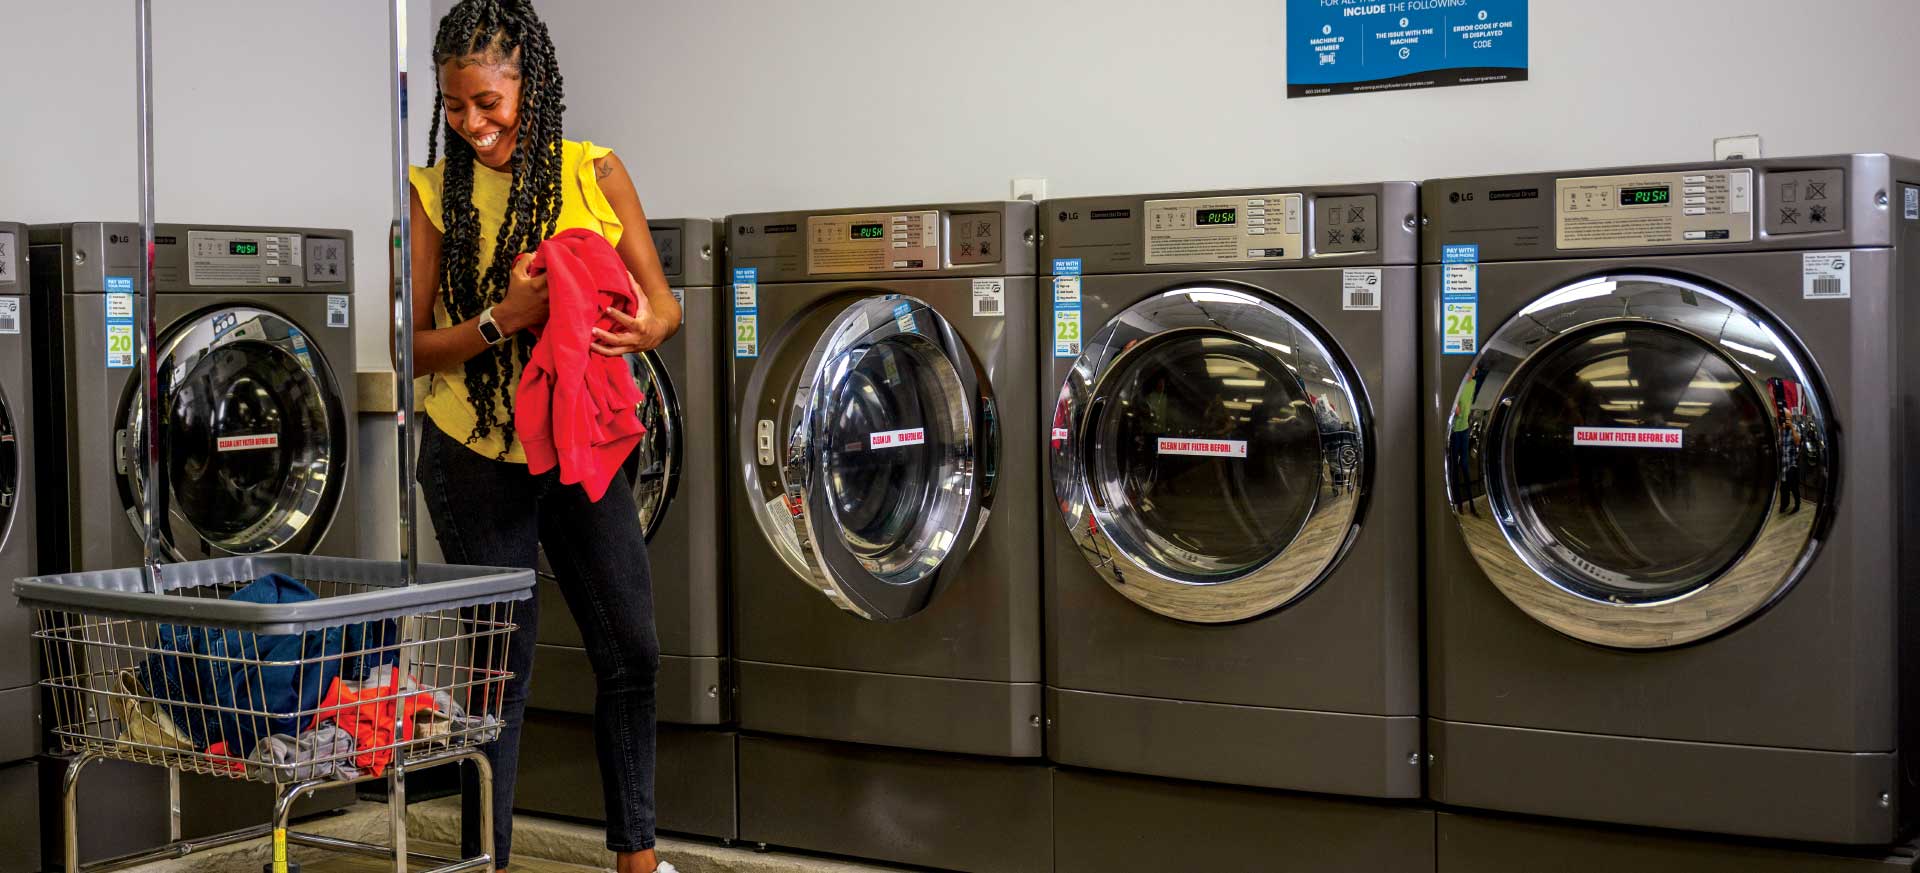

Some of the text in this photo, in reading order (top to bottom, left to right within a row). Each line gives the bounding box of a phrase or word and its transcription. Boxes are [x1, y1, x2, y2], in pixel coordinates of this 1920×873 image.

[1344, 0, 1467, 16] INCLUDE THE FOLLOWING.
[1470, 30, 1503, 38] DISPLAYED
[1473, 40, 1492, 48] CODE
[1462, 193, 1473, 201] LG
[1635, 190, 1667, 202] PUSH
[1208, 213, 1234, 222] PUSH
[861, 227, 883, 238] PUSH
[236, 244, 256, 254] PUSH
[1057, 322, 1078, 339] 23
[1446, 315, 1473, 335] 24
[738, 326, 755, 341] 22
[110, 336, 131, 351] 20
[873, 435, 884, 445] CLEAN
[1577, 432, 1679, 443] CLEAN LINT FILTER BEFORE USE
[1161, 442, 1177, 450] CLEAN
[1178, 442, 1190, 450] LINT
[1192, 443, 1209, 451] FILTER
